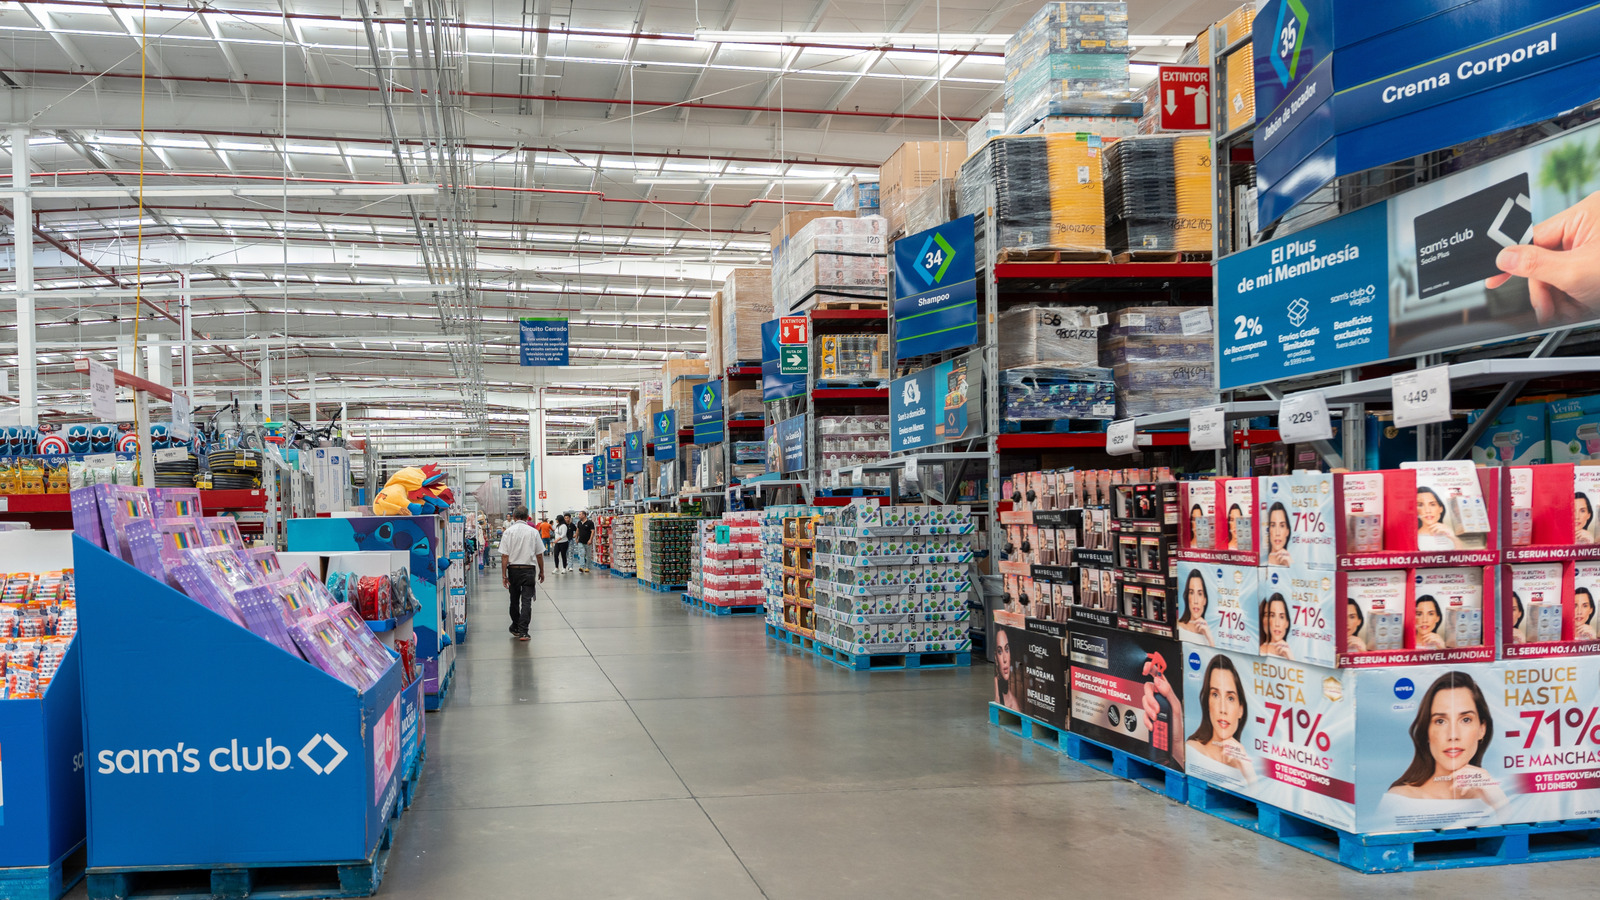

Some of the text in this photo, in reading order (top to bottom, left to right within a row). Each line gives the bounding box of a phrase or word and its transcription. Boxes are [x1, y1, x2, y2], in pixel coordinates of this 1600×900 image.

[1281, 17, 1296, 58] 35
[1382, 32, 1557, 103] Crema Corporal
[1162, 71, 1208, 82] EXTINTOR
[1264, 82, 1316, 140] Jabón de tocador
[867, 235, 880, 245] 120
[1420, 228, 1474, 257] sam's club
[926, 250, 942, 268] 34
[1272, 239, 1316, 264] El Plus
[1420, 251, 1450, 266] Socio Plus
[1238, 244, 1360, 294] de mi Membresía
[918, 293, 950, 307] Shampoo
[1330, 287, 1366, 304] sam's club
[1234, 315, 1263, 340] 2%
[1334, 314, 1372, 330] Beneficios
[1278, 326, 1320, 344] Envíos Gratis
[1334, 326, 1372, 342] exclusivos
[1224, 340, 1268, 356] de Recompensa
[1348, 340, 1357, 348] del
[1357, 337, 1370, 346] Club
[1293, 348, 1312, 358] pedidos
[704, 394, 711, 403] 30
[1288, 412, 1312, 424] $229
[1290, 484, 1318, 494] REDUCE
[1291, 498, 1318, 508] HASTA
[1292, 512, 1326, 532] 71%
[1292, 536, 1300, 544] DE
[1078, 552, 1112, 560] MAYBELLINE
[1341, 558, 1352, 566] EL
[1354, 557, 1388, 566] SERUM
[1390, 556, 1411, 564] NO.1
[1421, 556, 1448, 564] NIVEL
[1518, 550, 1548, 558] SERUM
[1550, 549, 1569, 557] NO.1
[1034, 568, 1063, 576] MAYBELLINE
[1218, 586, 1240, 596] REDUCE
[1291, 578, 1320, 589] REDUCE
[1218, 599, 1240, 609] HASTA
[1292, 592, 1320, 603] HASTA
[1076, 611, 1110, 622] MAYBELLINE
[1218, 610, 1246, 631] 71%
[1292, 606, 1326, 629] 71%
[1030, 622, 1060, 634] MAYBELLINE
[1506, 648, 1517, 656] EL
[1519, 646, 1548, 655] SERUM
[1550, 646, 1570, 654] NO.1
[1340, 657, 1352, 666] EL
[1353, 655, 1387, 664] SERUM
[1388, 654, 1410, 664] NO.1
[1410, 654, 1418, 662] A
[1419, 653, 1446, 662] NIVEL
[1026, 666, 1056, 682] PANORAMA
[1074, 672, 1092, 682] 2PACK
[1092, 676, 1109, 686] SPRAY
[1252, 662, 1304, 684] REDUCE
[1504, 666, 1576, 685] REDUCE
[1074, 680, 1132, 702] PROTECCIÓN TÉRMICA
[1254, 678, 1306, 705] HASTA
[1504, 686, 1578, 707] HASTA
[1256, 702, 1330, 752] -71%
[1506, 706, 1600, 749] -71%
[1255, 738, 1268, 753] DE
[98, 742, 200, 774] sam's
[209, 738, 292, 772] club
[1504, 755, 1524, 769] DE
[1275, 763, 1330, 786] O TE DEVOLVEMOS
[1275, 772, 1306, 788] TU DINERO
[1535, 772, 1600, 782] O TE DEVOLVEMO
[1548, 782, 1578, 790] DINERO
